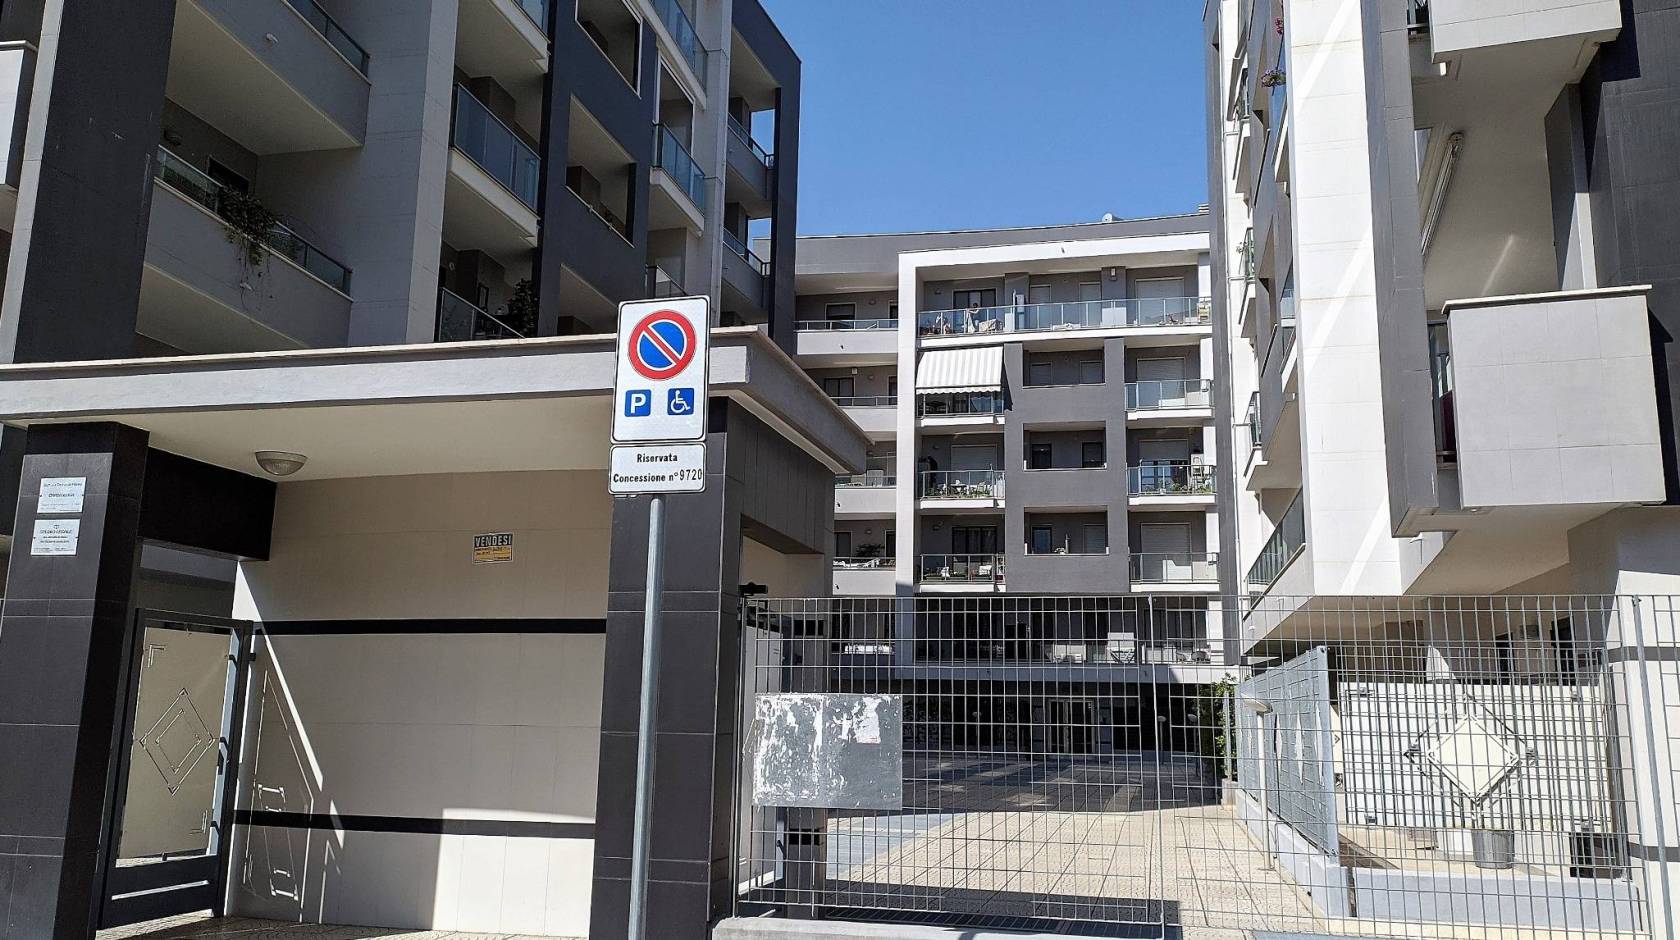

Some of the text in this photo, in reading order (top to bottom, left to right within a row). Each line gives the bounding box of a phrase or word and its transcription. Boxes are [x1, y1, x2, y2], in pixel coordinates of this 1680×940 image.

[630, 393, 647, 414] P
[636, 453, 678, 463] Riservata
[613, 473, 666, 483] Concessione
[475, 535, 511, 546] VENDESI
